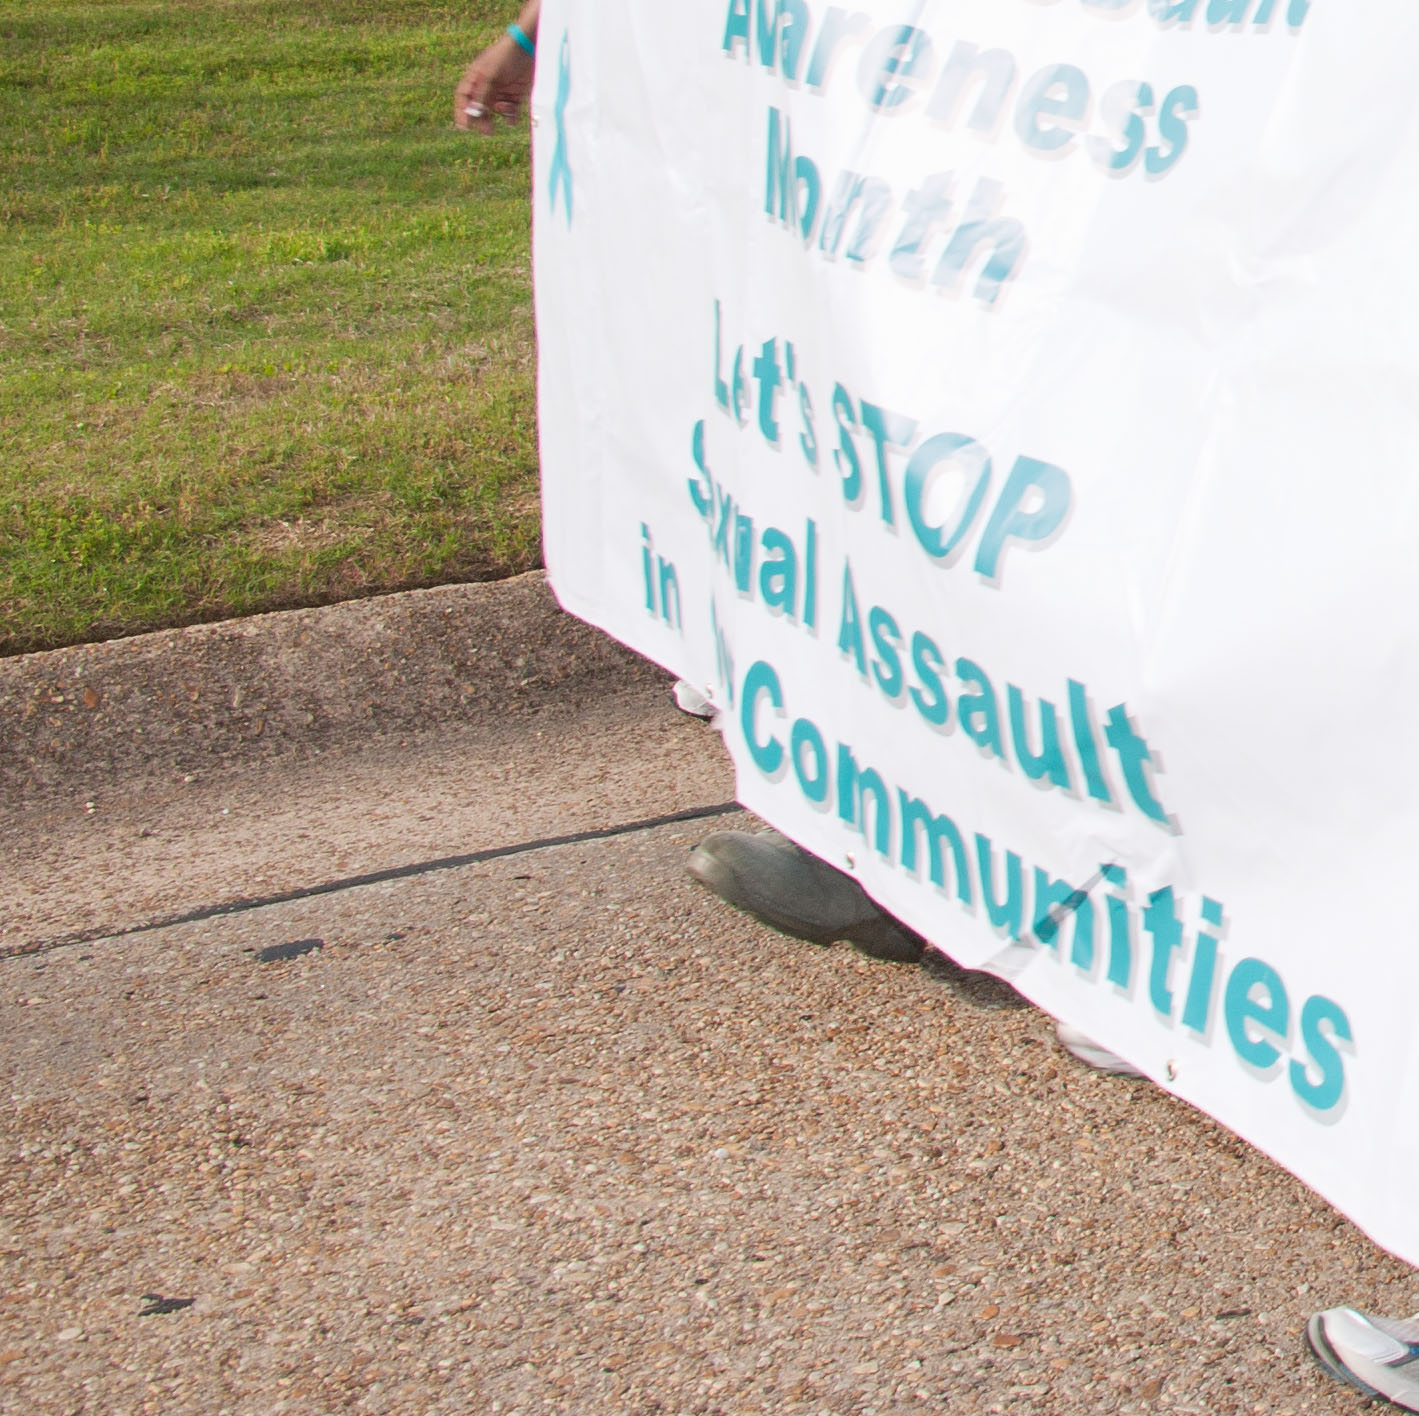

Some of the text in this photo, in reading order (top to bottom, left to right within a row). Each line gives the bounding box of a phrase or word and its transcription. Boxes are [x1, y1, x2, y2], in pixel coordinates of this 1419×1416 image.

[831, 381, 1073, 580] STOP
[640, 521, 1352, 1110] in Communities
[838, 555, 1172, 825] Assault
